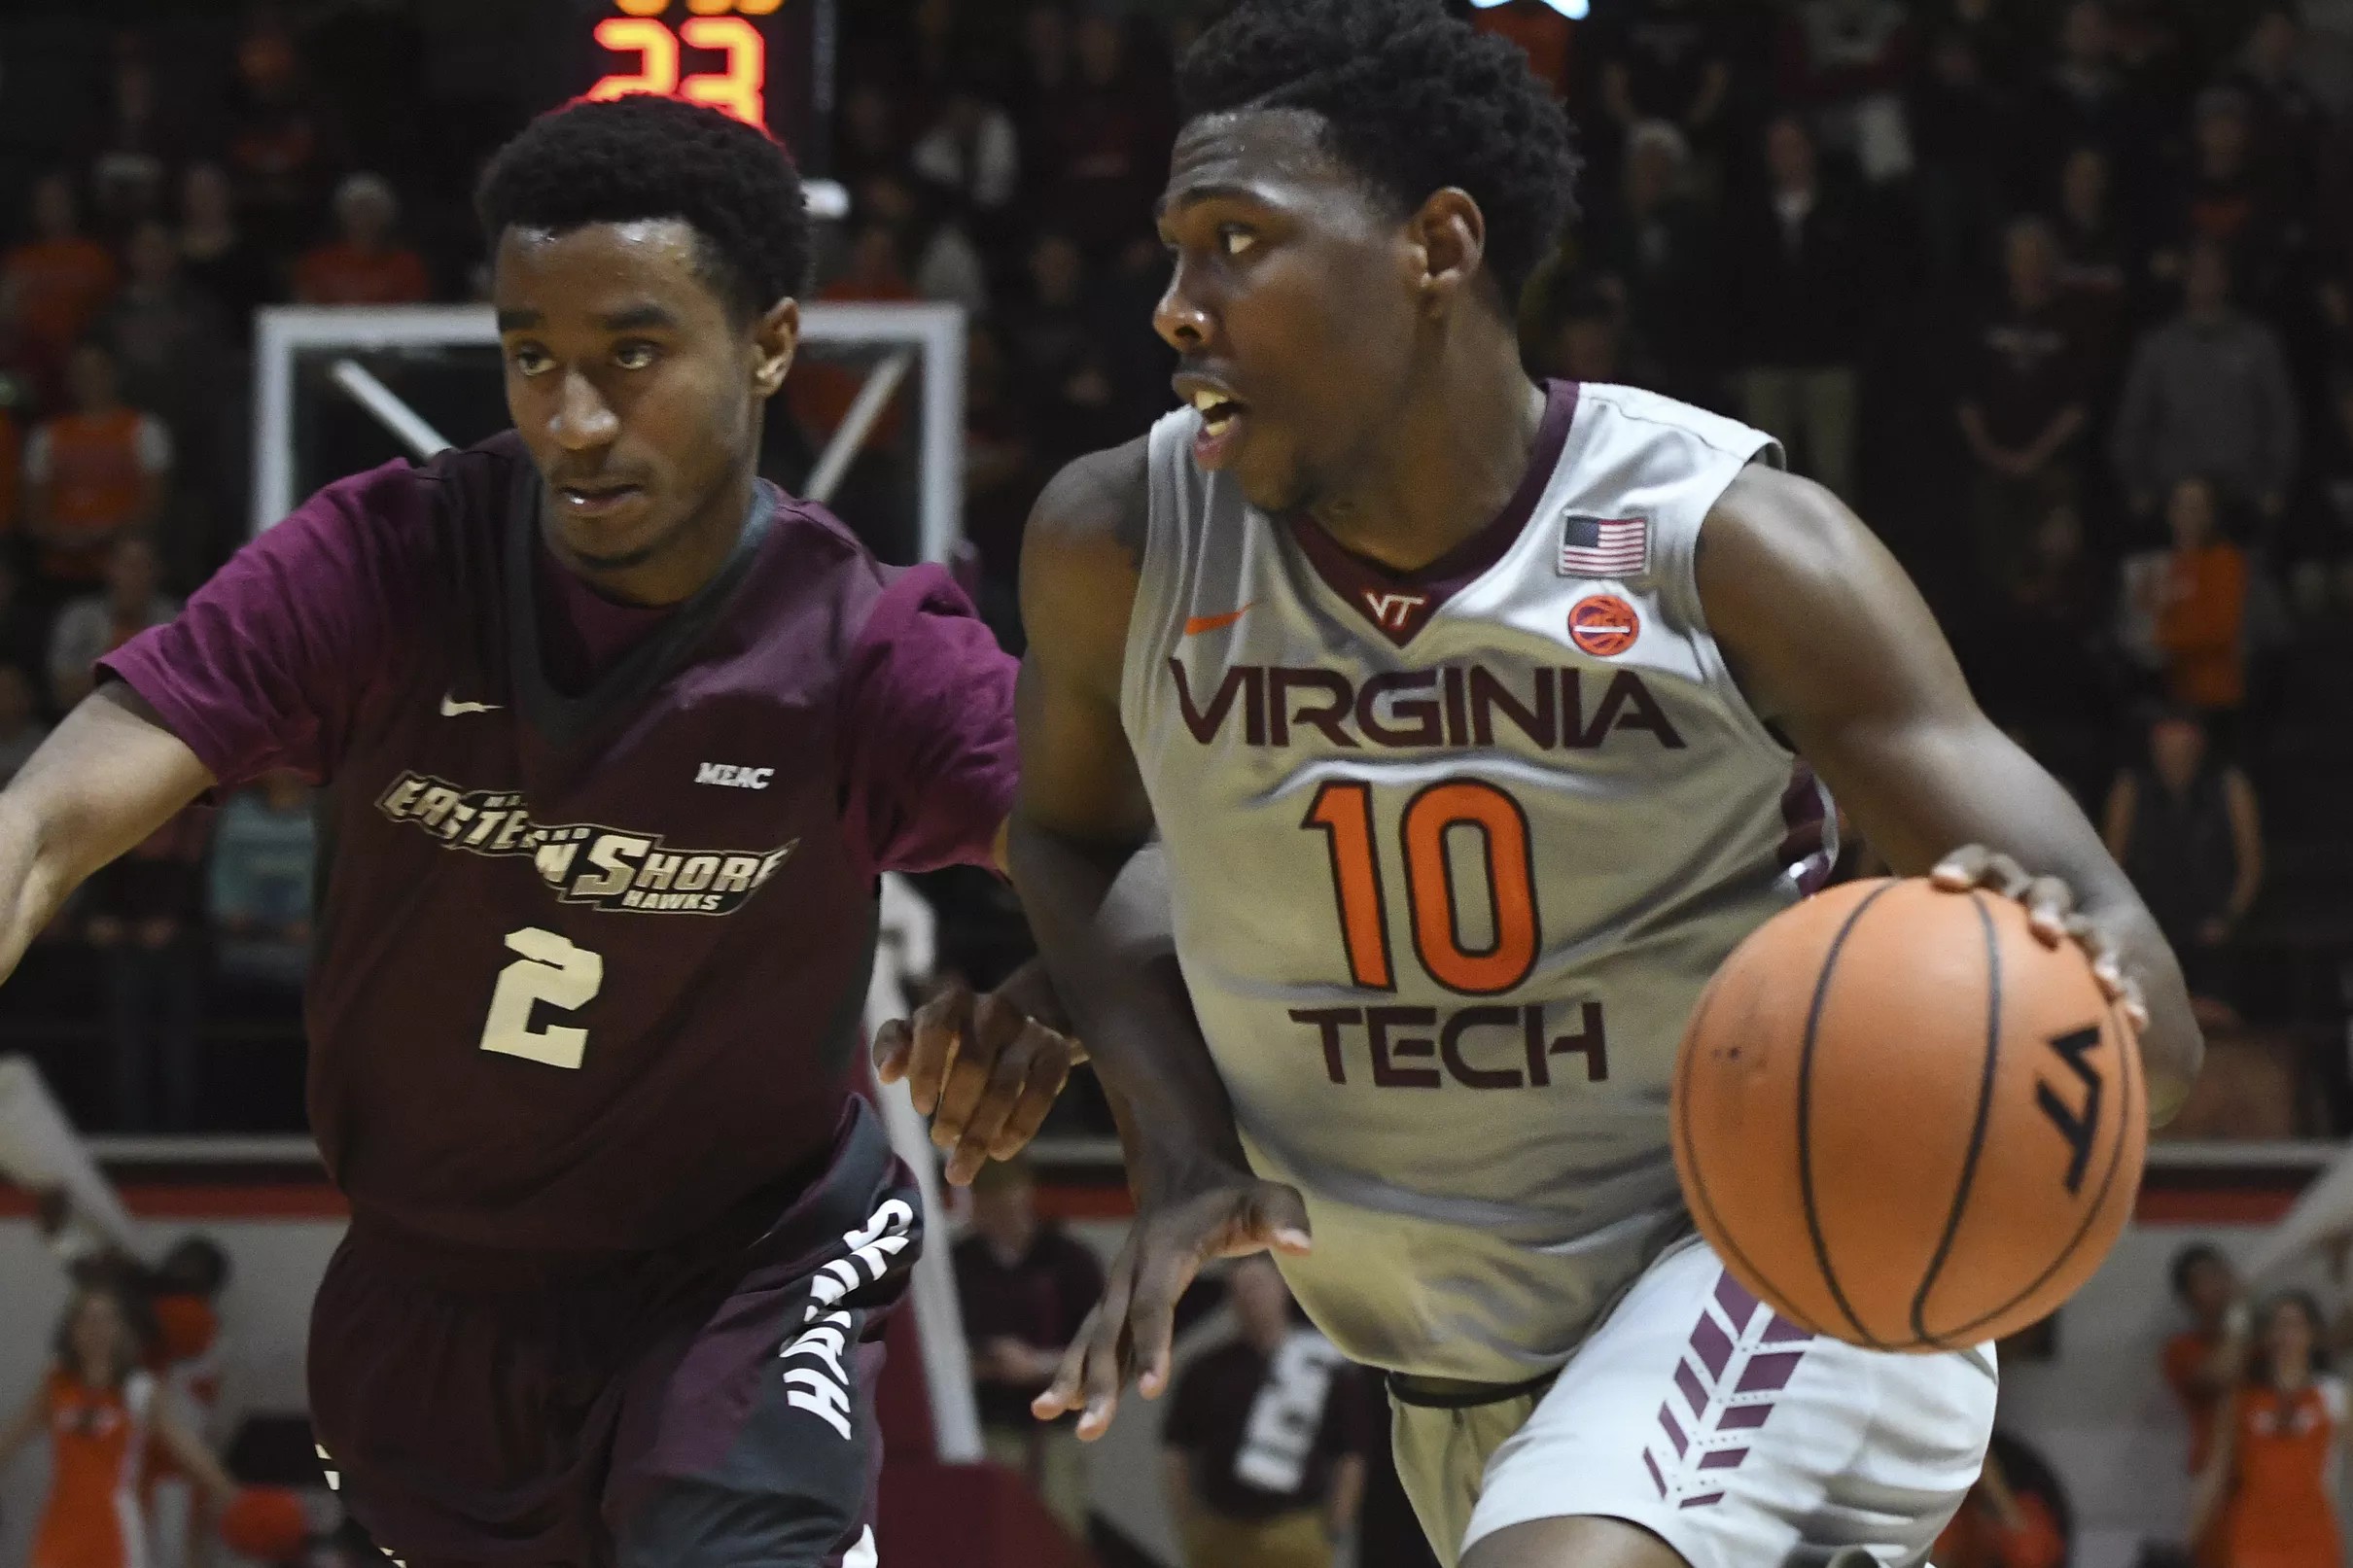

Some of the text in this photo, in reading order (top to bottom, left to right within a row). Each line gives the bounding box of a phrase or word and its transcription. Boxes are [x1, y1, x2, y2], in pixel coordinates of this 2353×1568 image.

[1363, 589, 1427, 629] VT
[1168, 656, 1687, 749] VIRGINIA
[694, 762, 775, 790] MEAC
[571, 834, 789, 896] SHORE
[620, 889, 723, 912] HAWKS
[1300, 778, 1542, 996] 10
[479, 926, 604, 1069] 2
[1288, 1002, 1609, 1090] TECH
